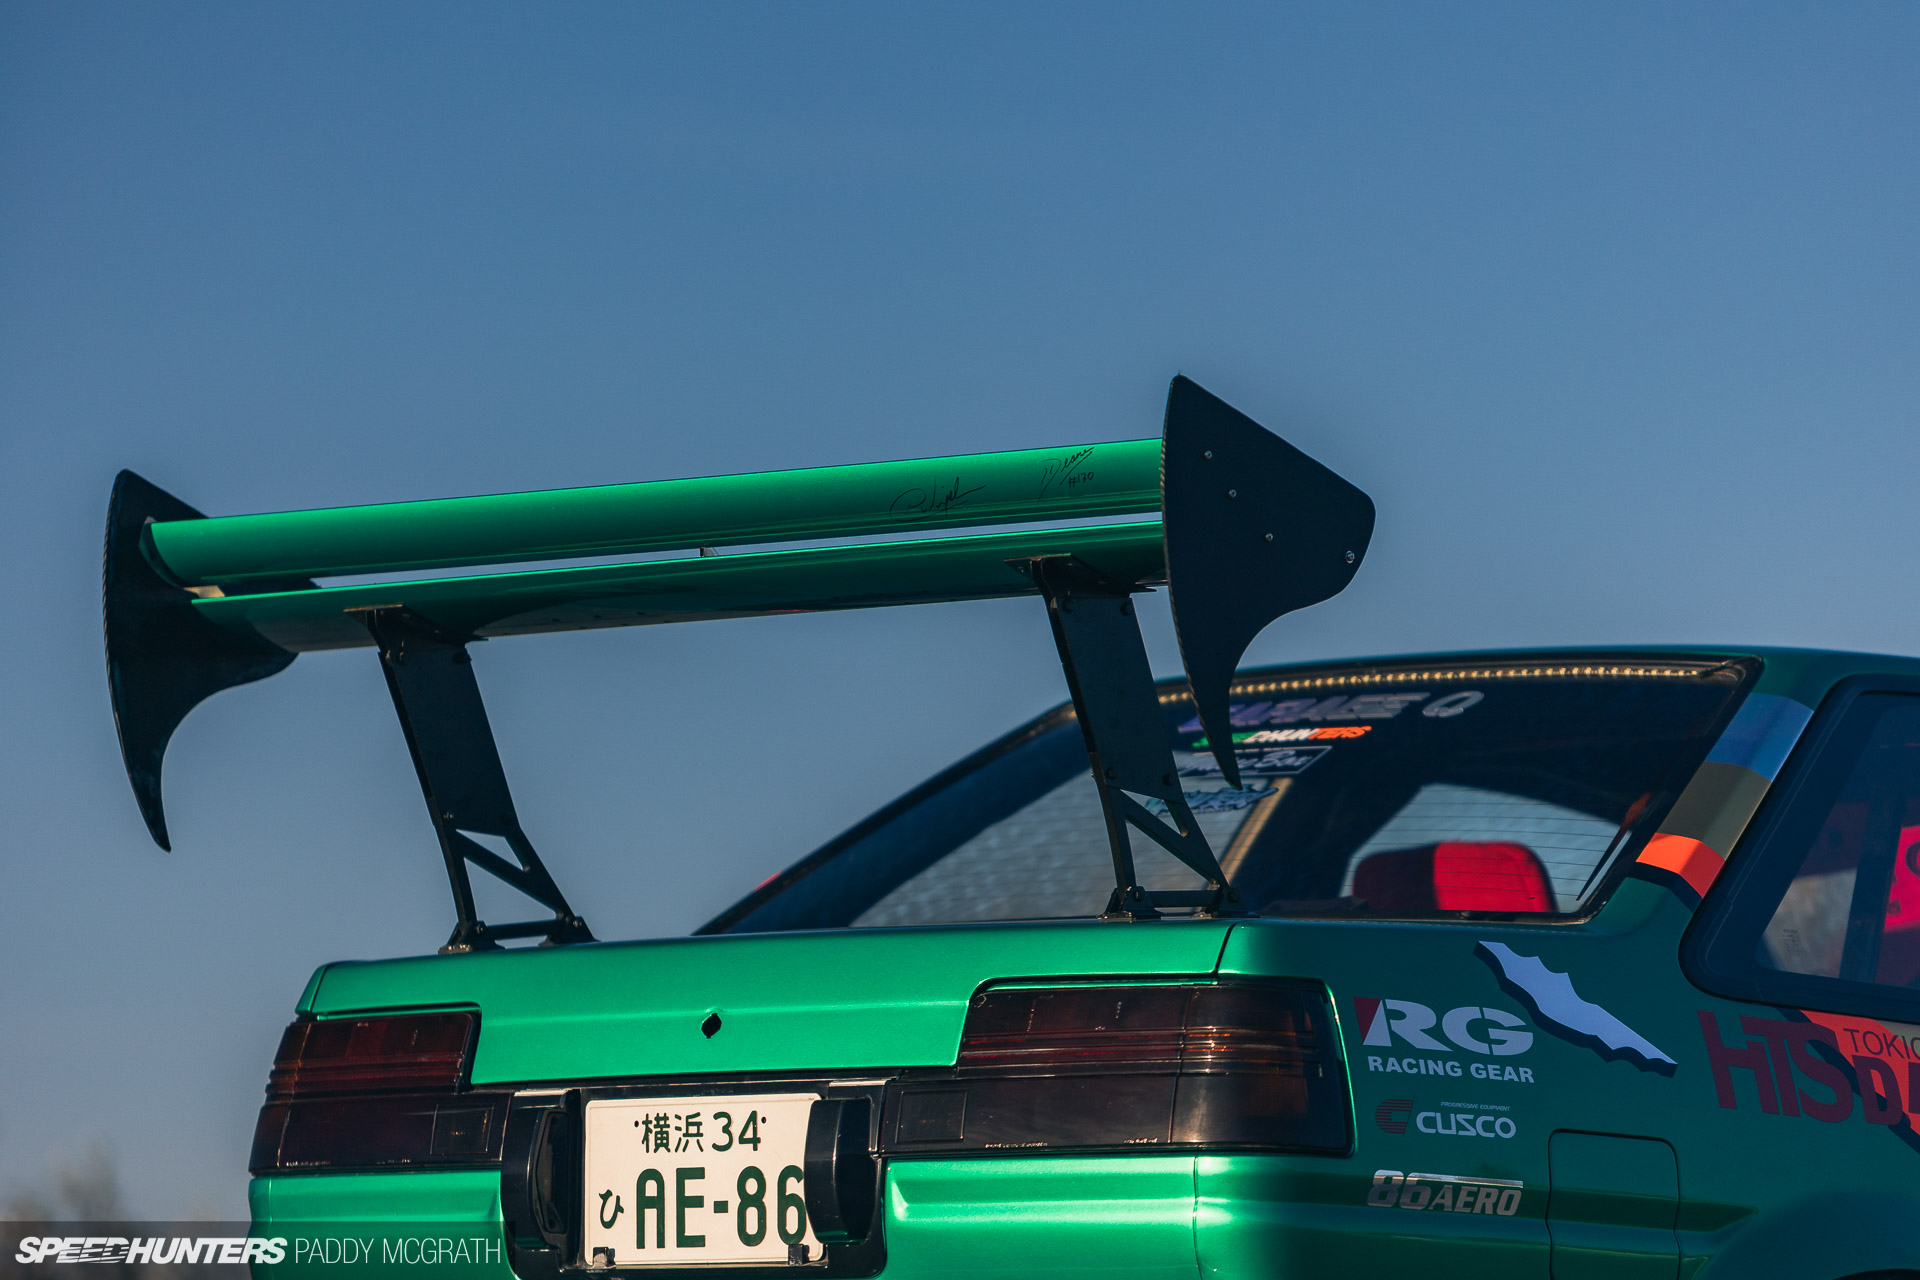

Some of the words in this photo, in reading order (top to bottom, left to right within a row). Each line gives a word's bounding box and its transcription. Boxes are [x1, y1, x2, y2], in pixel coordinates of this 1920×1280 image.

[1353, 997, 1534, 1056] RG
[1367, 1055, 1463, 1077] RACING
[1470, 1063, 1535, 1083] GEAR
[641, 1112, 704, 1153] 横浜
[711, 1110, 761, 1151] 34
[1416, 1111, 1516, 1138] CUSCO
[599, 1189, 625, 1229] ひ
[636, 1165, 806, 1249] AE-86
